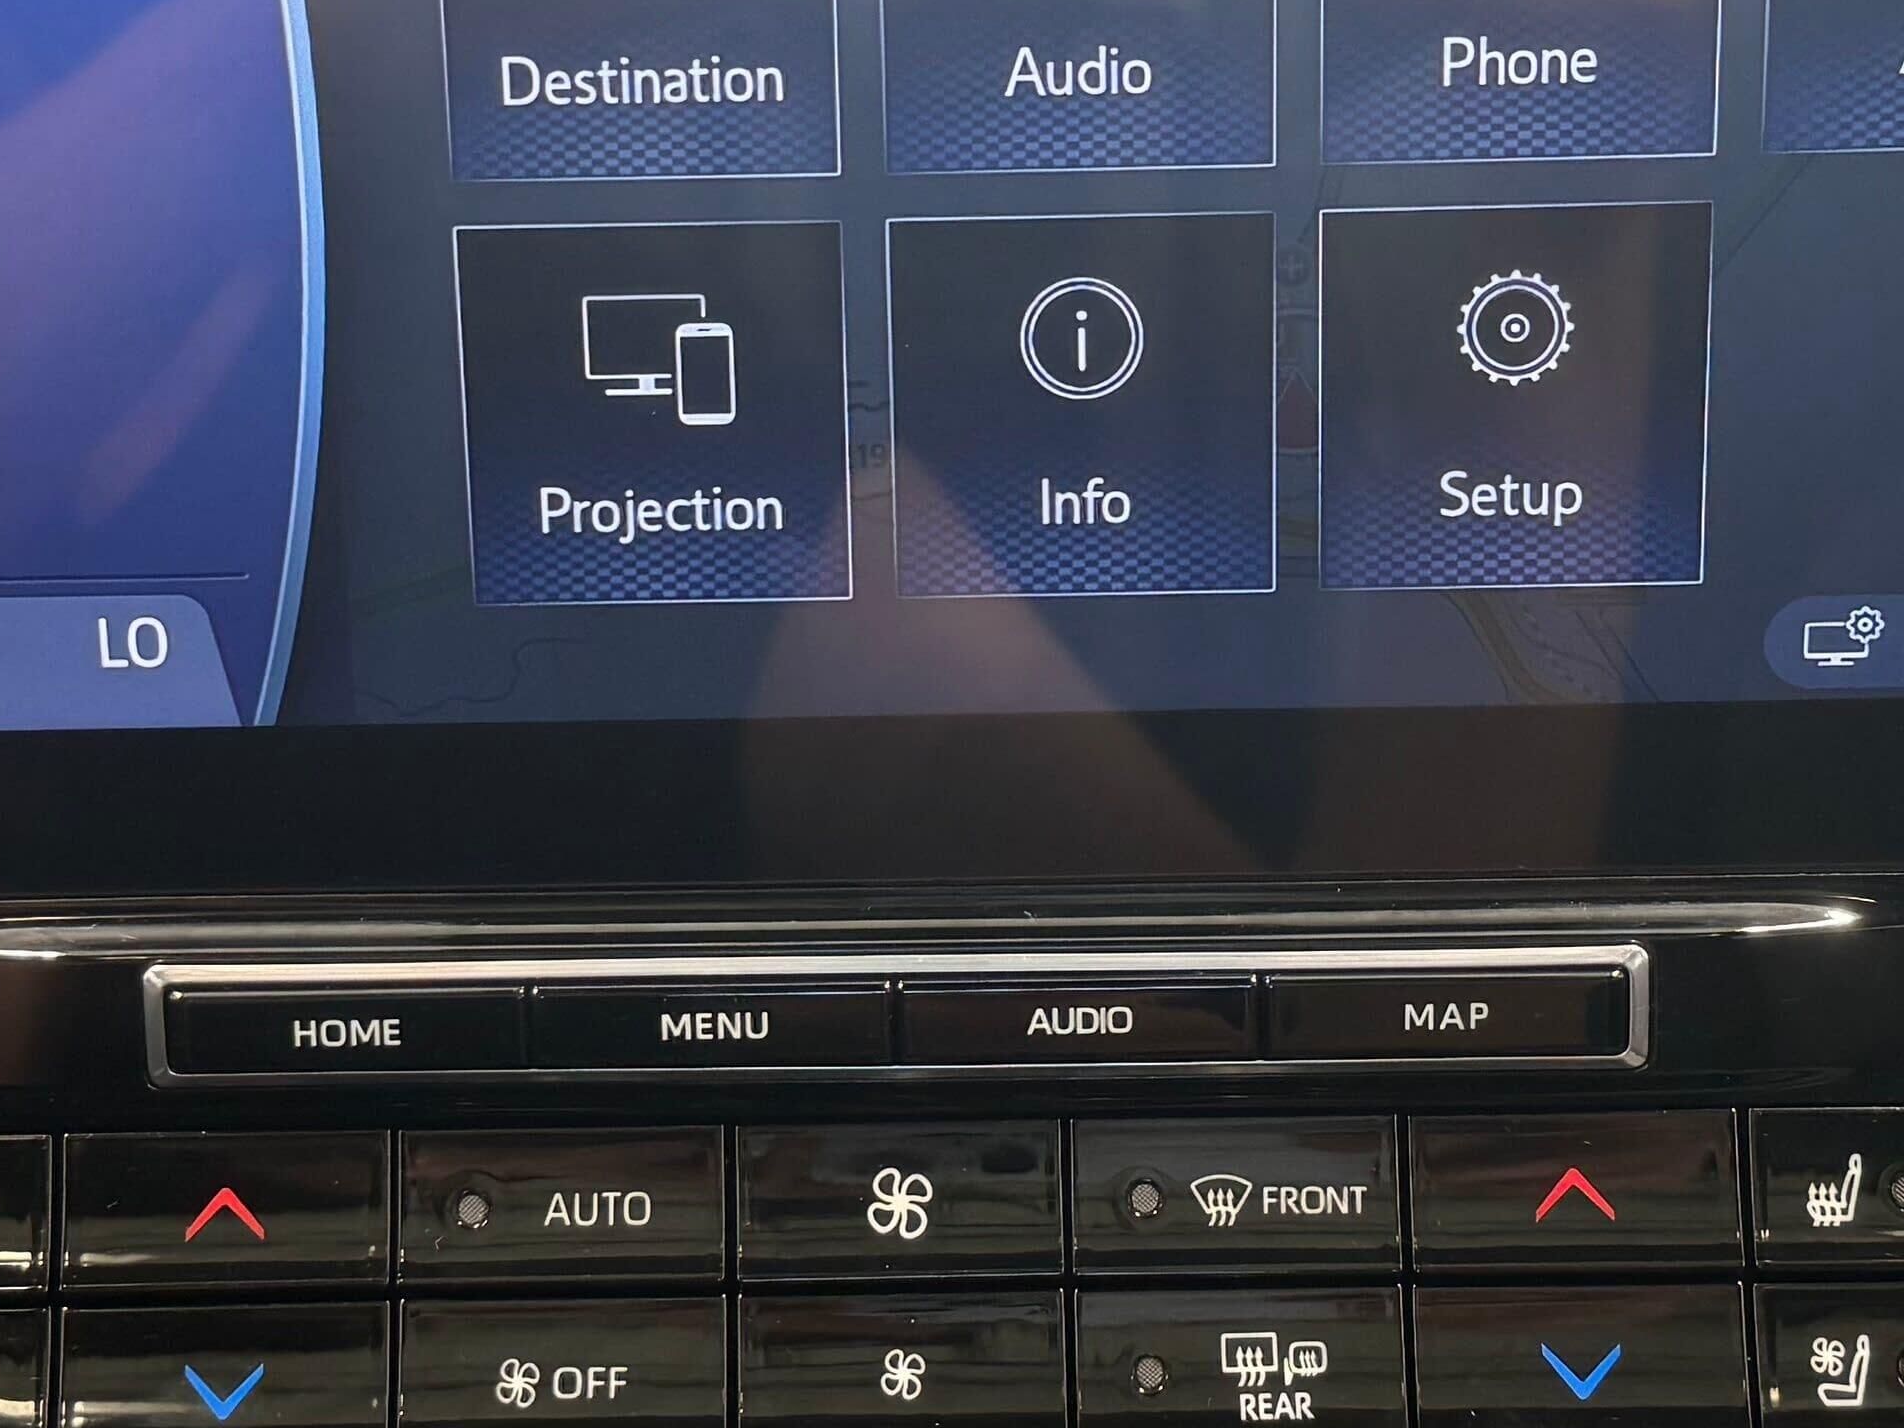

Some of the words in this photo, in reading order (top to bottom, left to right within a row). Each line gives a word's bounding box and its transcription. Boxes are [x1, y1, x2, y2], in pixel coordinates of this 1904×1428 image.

[1003, 45, 1154, 99] Audio
[1439, 34, 1599, 88] Phone
[499, 53, 787, 108] Destination
[538, 484, 787, 546] Projection
[1039, 476, 1134, 529] Info
[1437, 469, 1585, 526] Setup
[95, 614, 170, 670] LO
[292, 1018, 402, 1048] HOME
[659, 1010, 771, 1042] MENU
[1026, 1004, 1134, 1036] AUDIO
[1402, 1001, 1490, 1033] MAP
[543, 1190, 653, 1228] AUTO
[1261, 1183, 1369, 1217] FRONT
[552, 1364, 629, 1401] OFF
[1237, 1391, 1315, 1422] REAR
